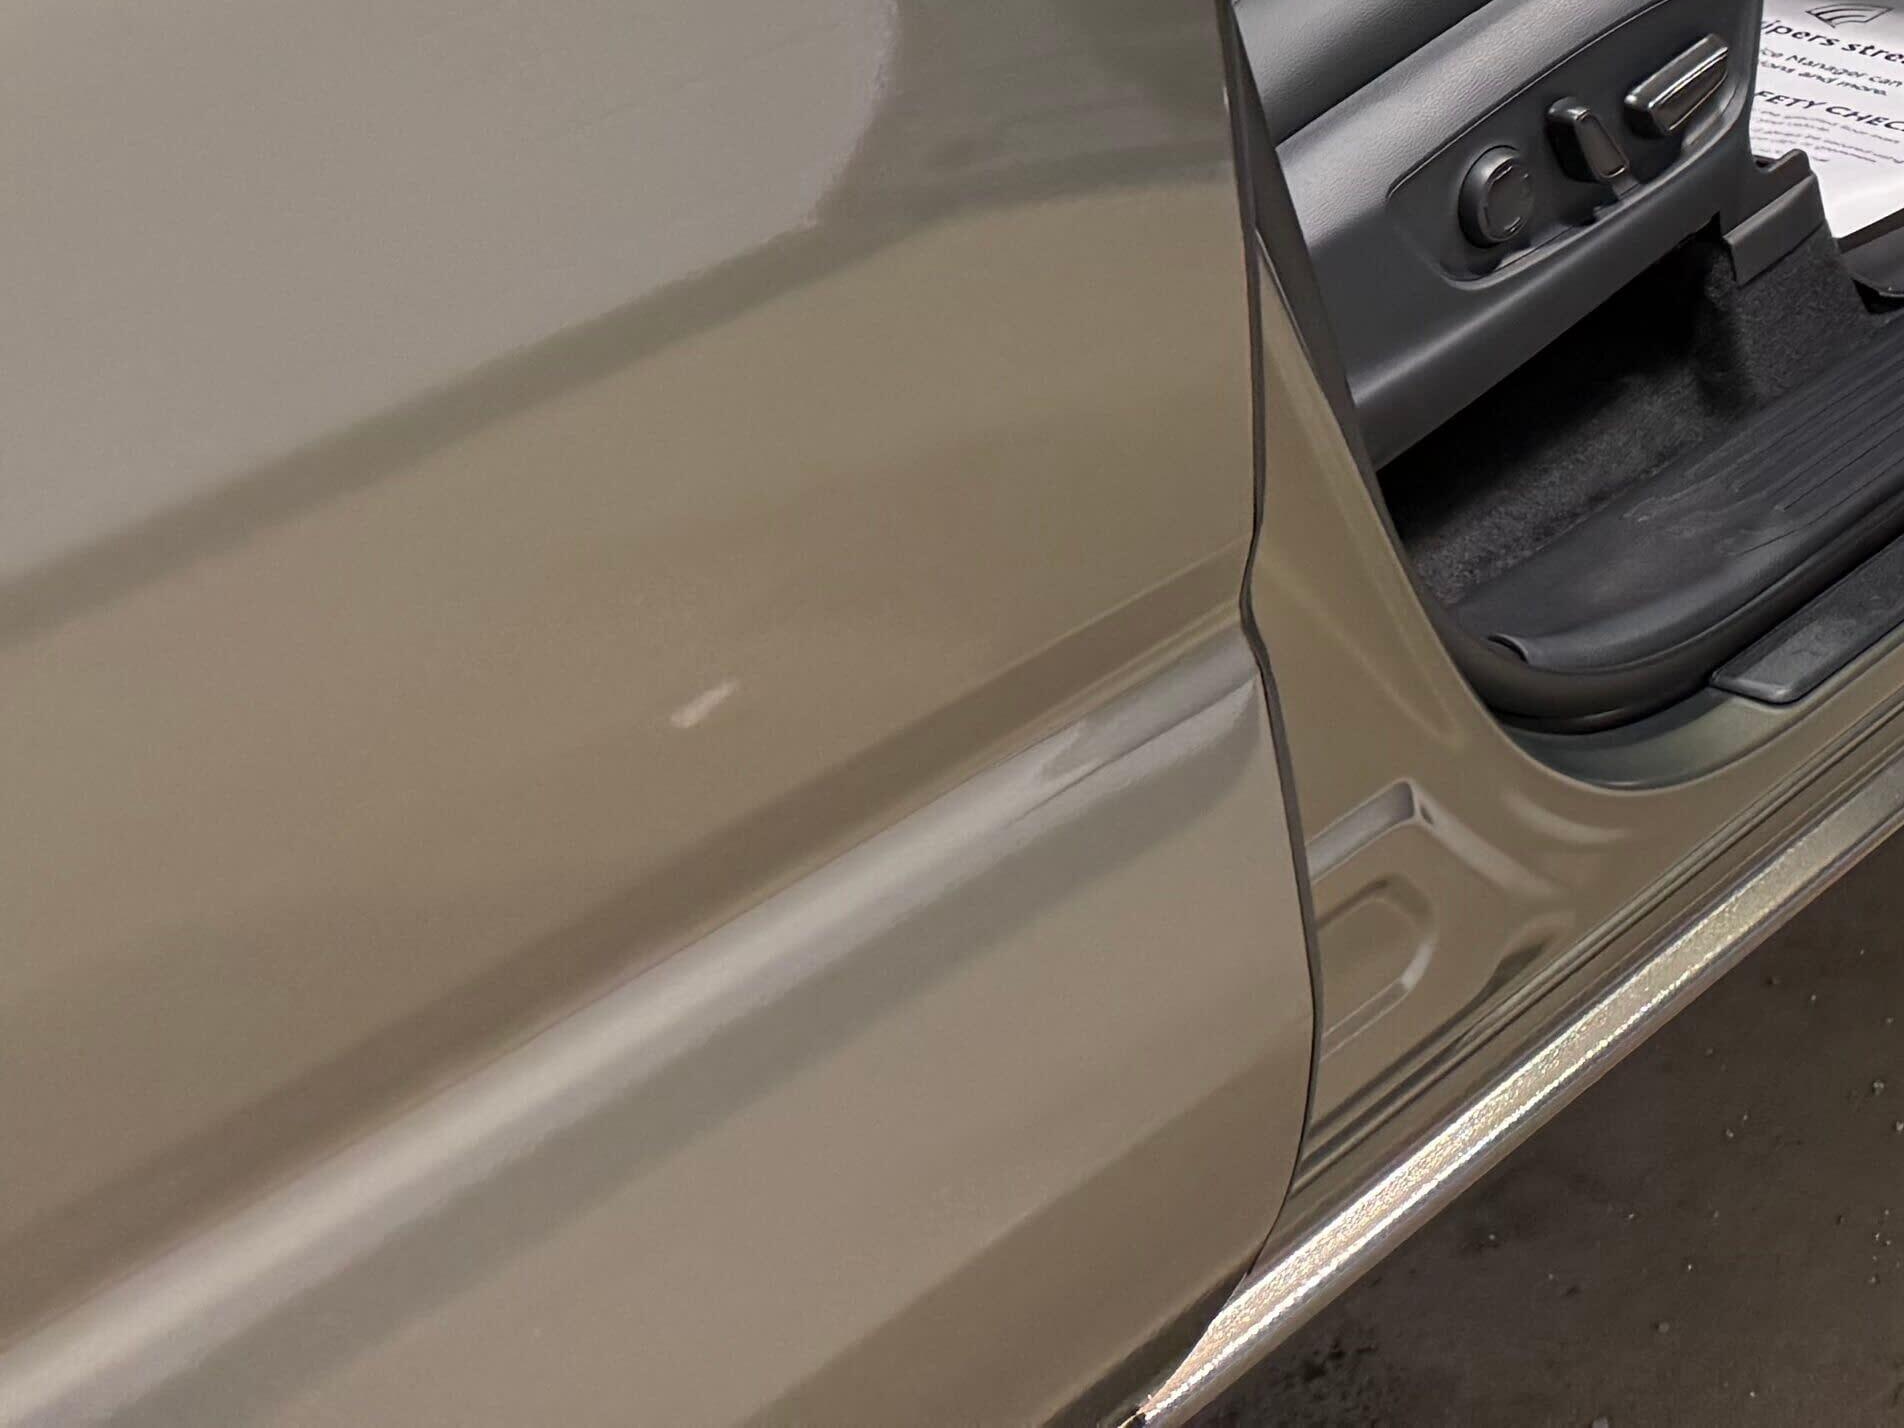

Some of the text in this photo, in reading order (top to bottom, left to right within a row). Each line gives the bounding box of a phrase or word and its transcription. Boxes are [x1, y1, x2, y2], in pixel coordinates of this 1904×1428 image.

[1761, 18, 1840, 47] ipers
[1786, 54, 1866, 79] Manager
[1868, 74, 1904, 89] can
[1797, 69, 1837, 85] and
[1755, 90, 1828, 110] FETY
